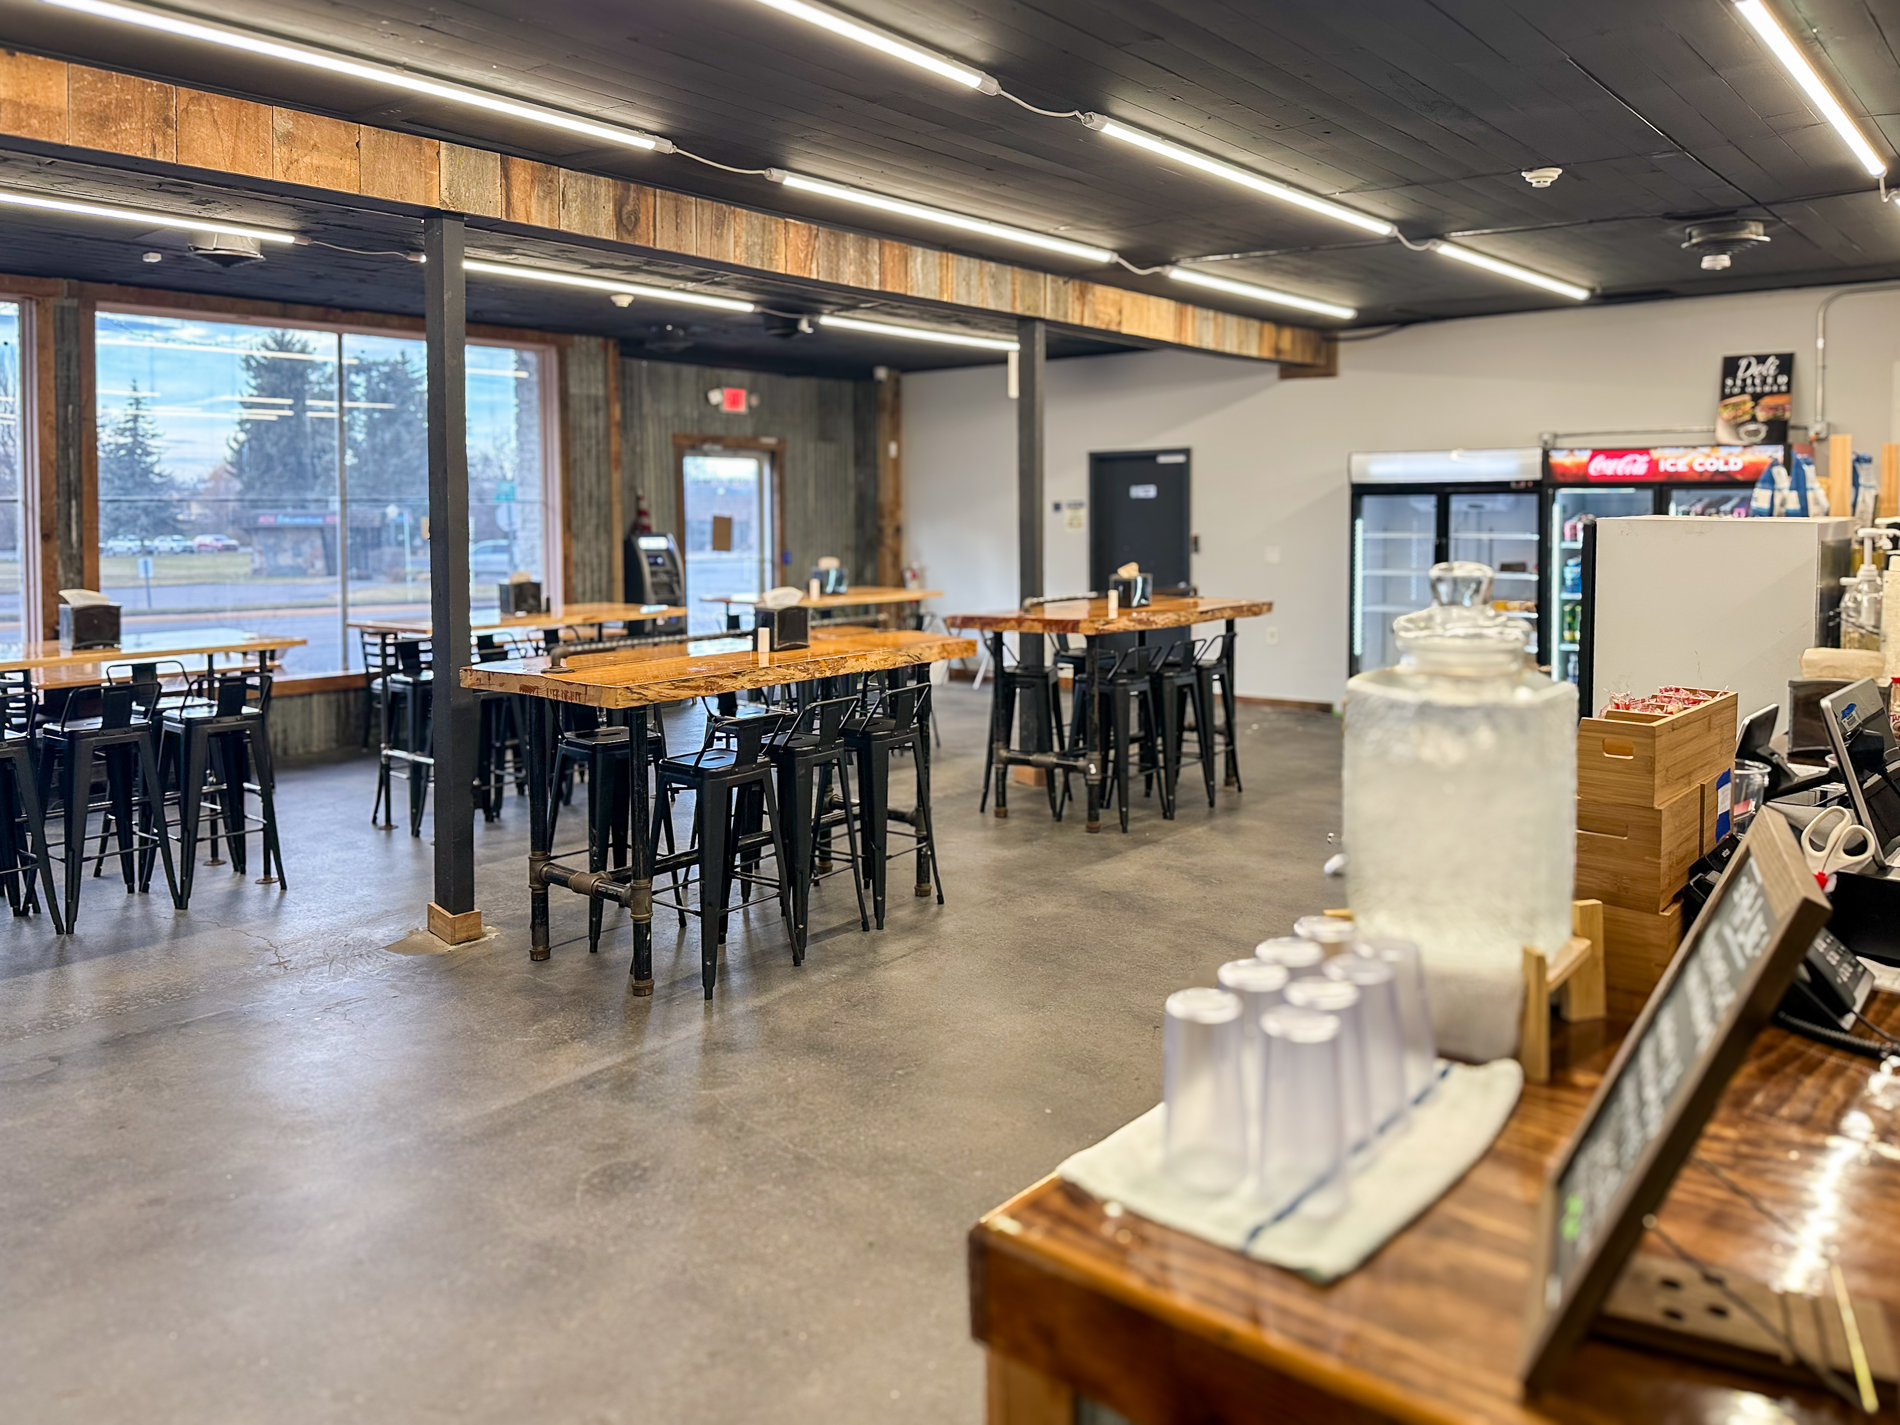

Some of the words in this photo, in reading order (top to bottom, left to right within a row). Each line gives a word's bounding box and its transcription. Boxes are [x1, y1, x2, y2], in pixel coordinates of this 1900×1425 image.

[1737, 355, 1780, 378] Deli
[1588, 454, 1651, 476] Coca-Cola
[1658, 457, 1690, 473] ICE
[1692, 456, 1744, 472] COLD
